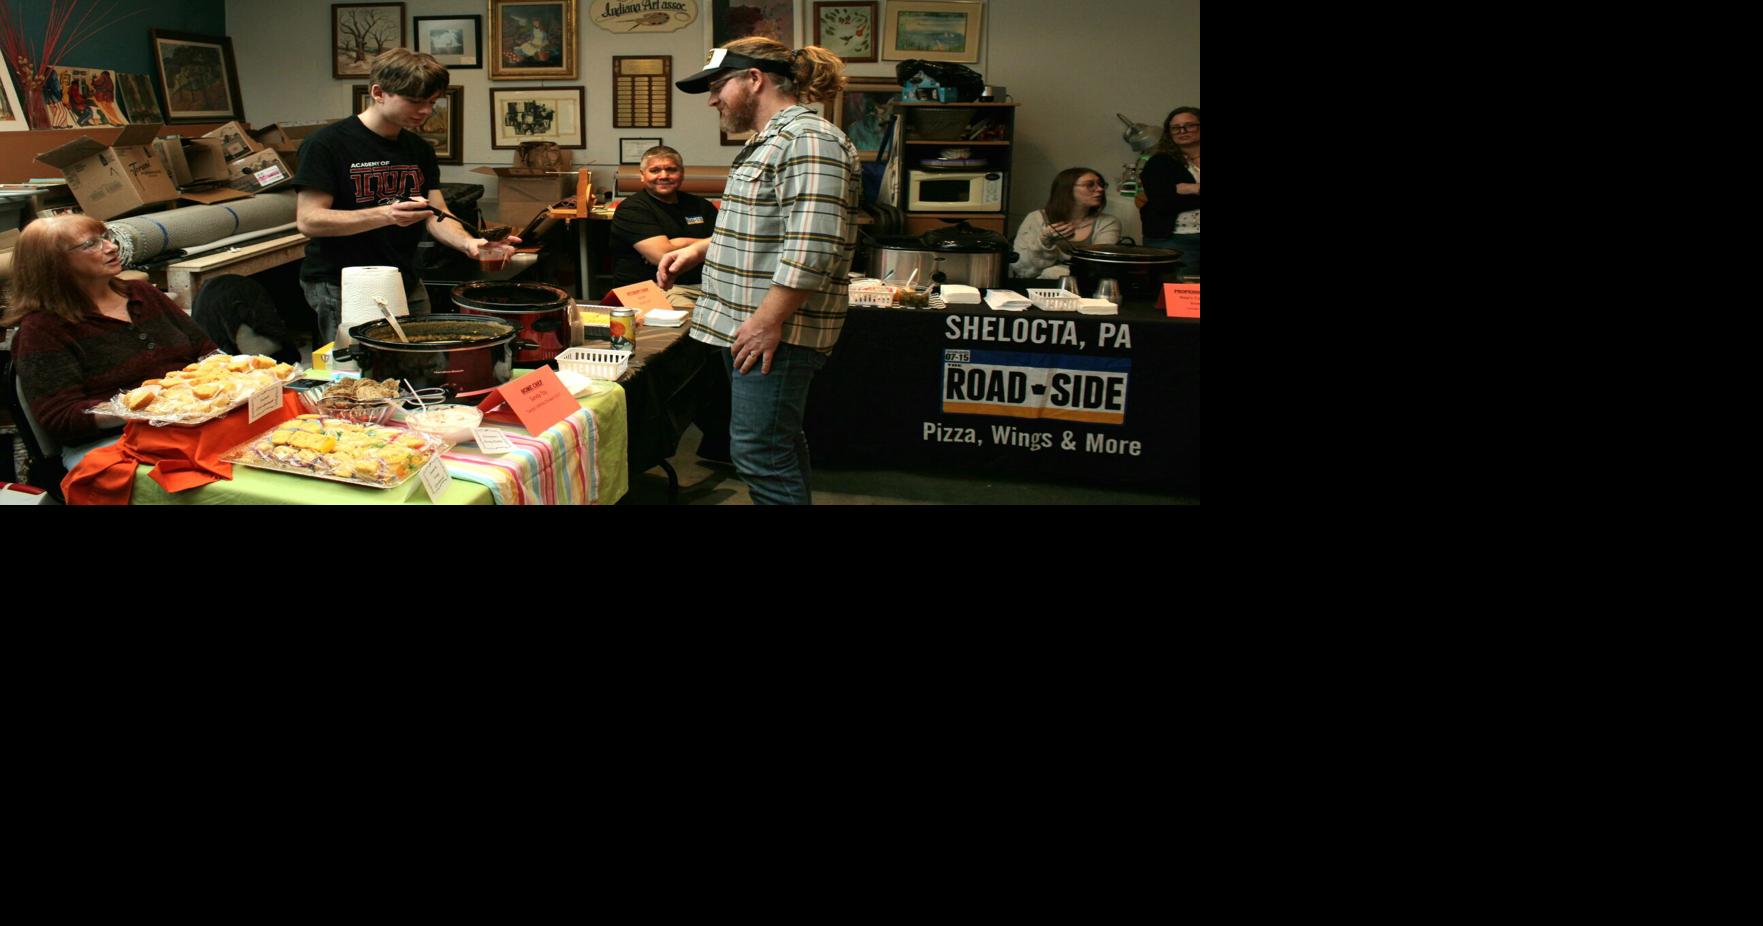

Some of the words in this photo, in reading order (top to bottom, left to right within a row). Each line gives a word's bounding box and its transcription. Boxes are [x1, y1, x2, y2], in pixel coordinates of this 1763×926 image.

[601, 2, 641, 17] Indiana
[641, 0, 660, 11] Art
[944, 314, 1085, 350] SHELOCTA,
[1098, 322, 1132, 349] PA
[946, 367, 1027, 404] ROAD
[1050, 373, 1124, 411] SIDE
[923, 422, 983, 446] Pizza,
[991, 425, 1053, 451] Wings
[1061, 430, 1076, 451] &
[1085, 433, 1142, 456] More
